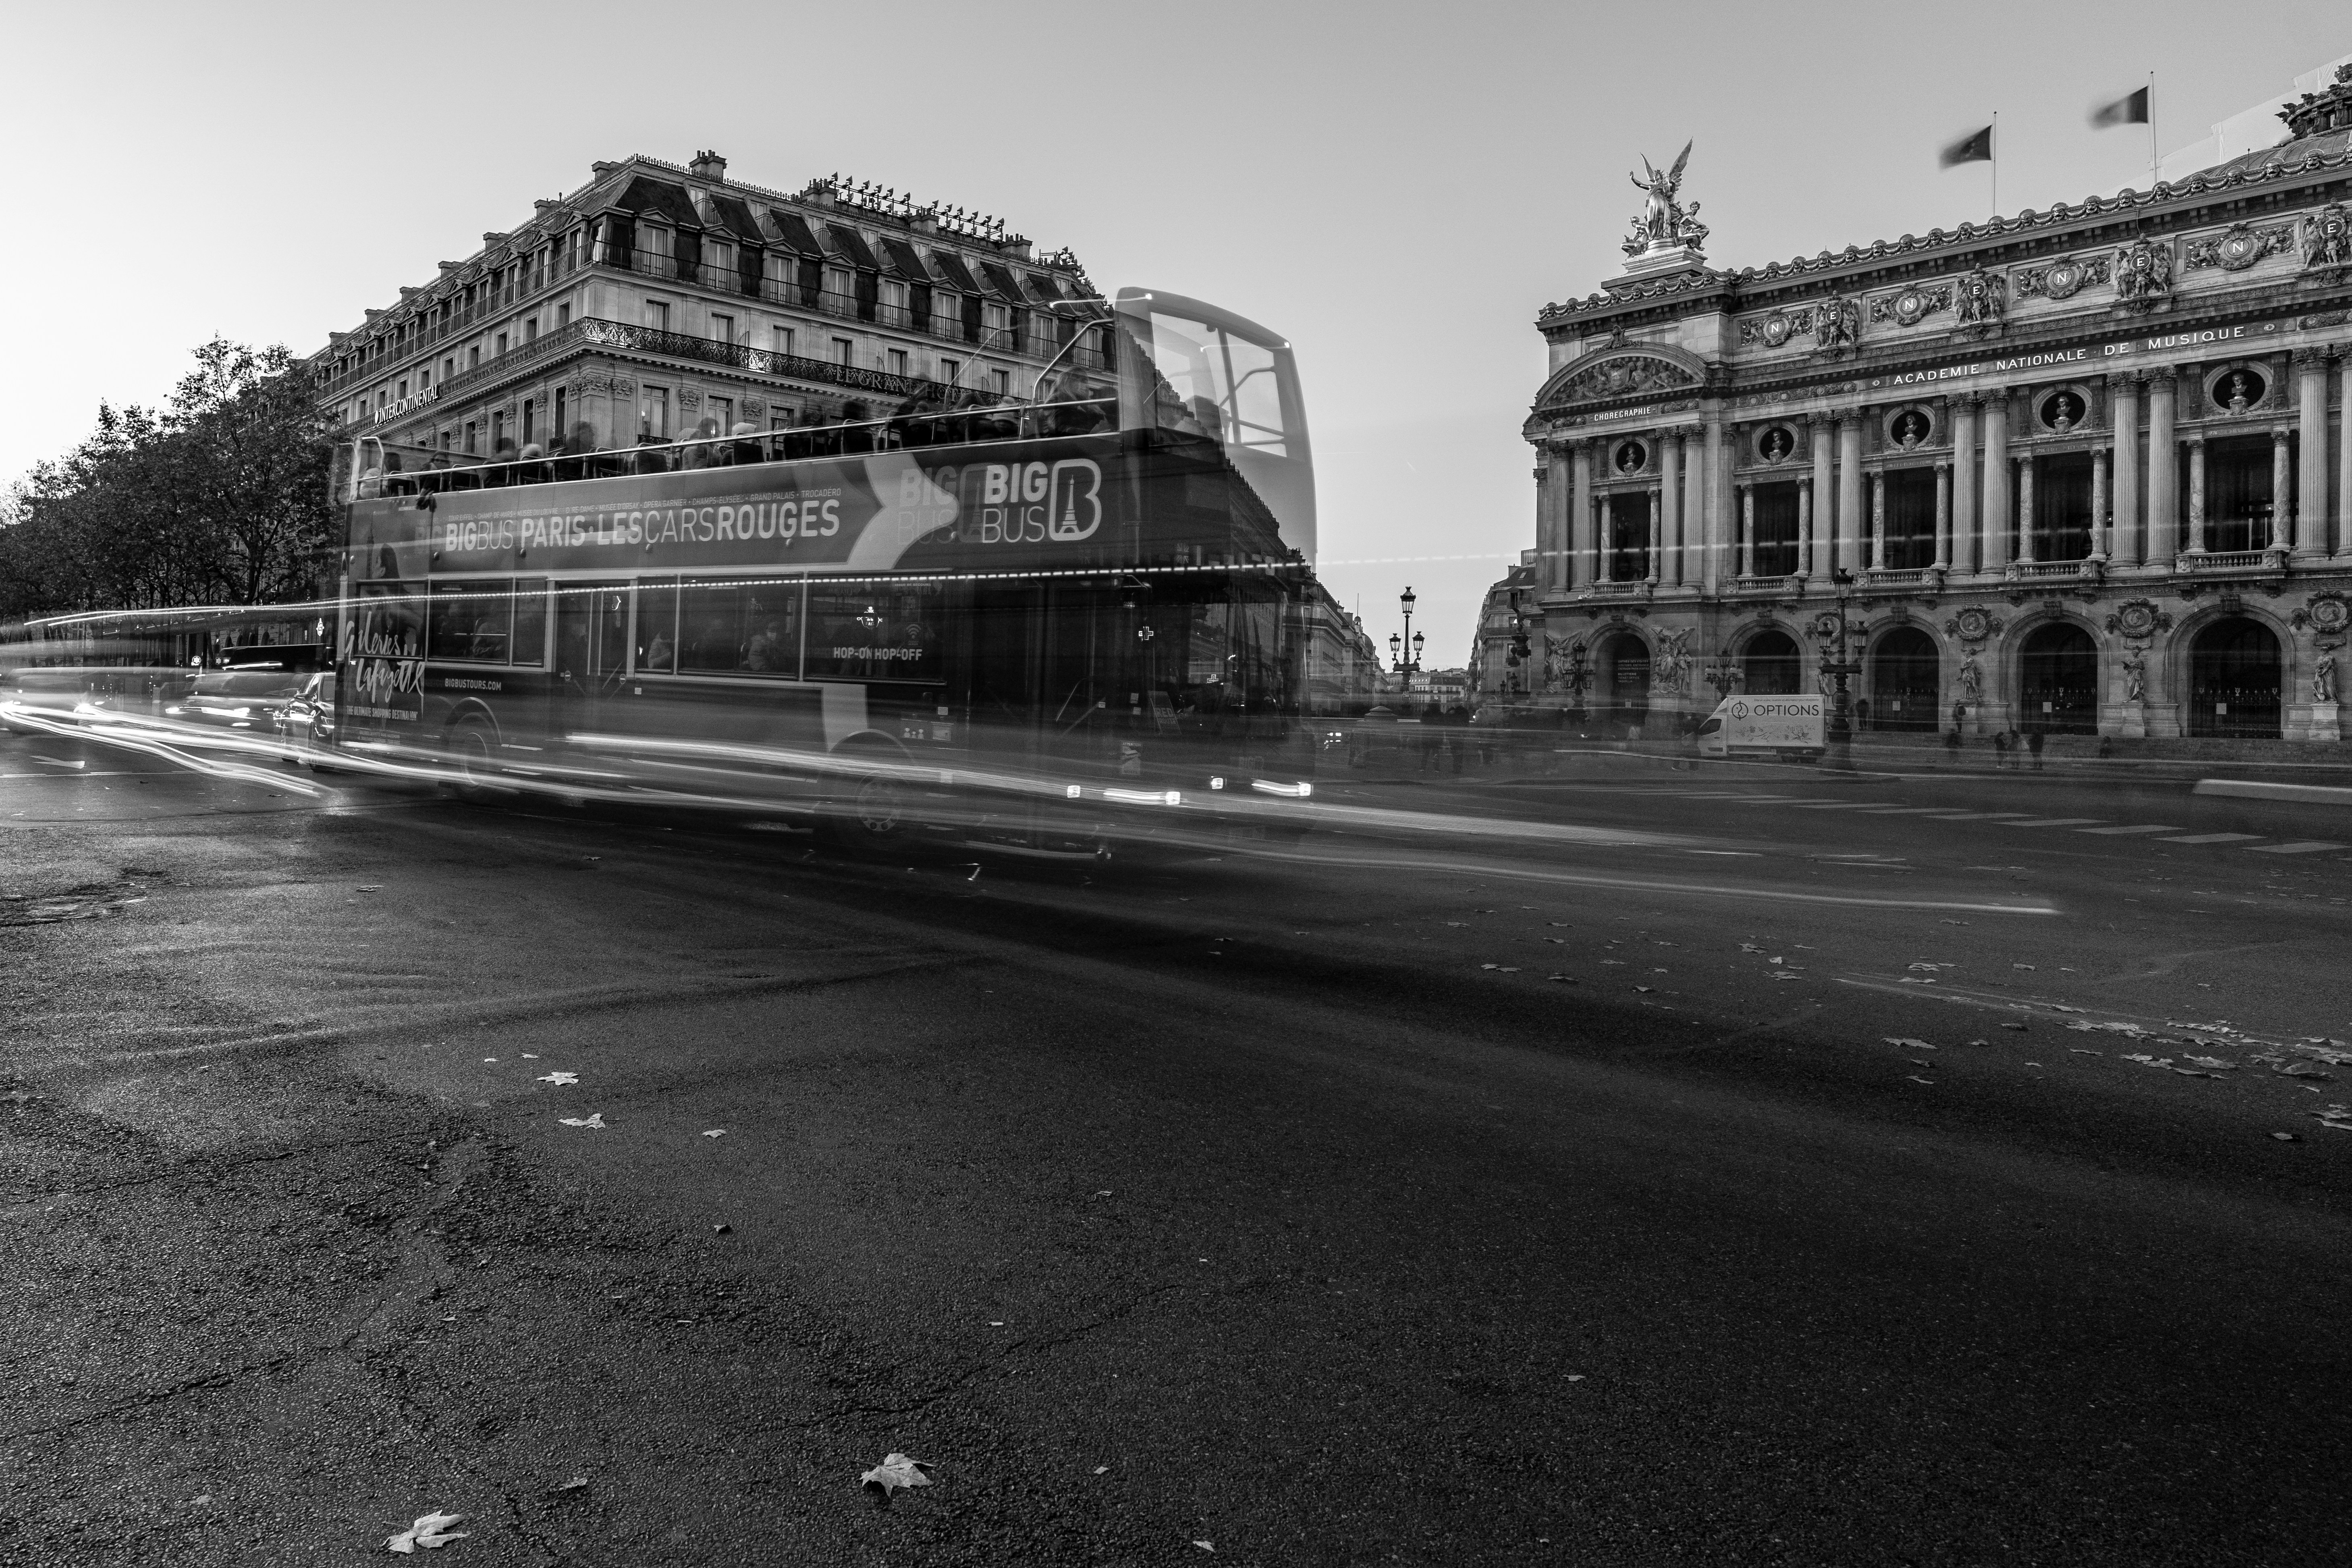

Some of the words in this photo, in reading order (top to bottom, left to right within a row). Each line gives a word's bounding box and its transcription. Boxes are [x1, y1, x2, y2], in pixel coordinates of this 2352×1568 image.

[2327, 223, 2336, 233] E
[2232, 241, 2244, 253] N
[2137, 257, 2144, 266] E
[2057, 272, 2067, 283] N
[1973, 286, 1980, 295] E
[1905, 299, 1914, 309] N
[1830, 312, 1836, 320] E
[1771, 324, 1779, 333] N
[1894, 364, 1979, 385] ACADEMIE
[1997, 349, 2086, 370] NATIONALE
[2105, 343, 2129, 355] DE
[2149, 326, 2244, 349] MUSIQUE
[379, 384, 438, 424] INTERCONTINENTAL
[1594, 407, 1650, 421] CHOREGRAPHIE
[984, 461, 1048, 504] BIG
[750, 492, 772, 502] GRAND
[773, 491, 795, 500] PALAIS
[802, 486, 841, 498] TROCADÉRO
[982, 506, 1045, 543] BUS
[445, 520, 513, 551] BIGBUS
[834, 647, 872, 659] HOP-ON
[875, 648, 922, 660] HOP-OFF
[445, 678, 502, 691] BIGBUSTOURS.COM
[354, 706, 372, 717] ULTIMATE
[372, 707, 391, 719] SHOPPING
[1754, 704, 1819, 716] OPTIONS
